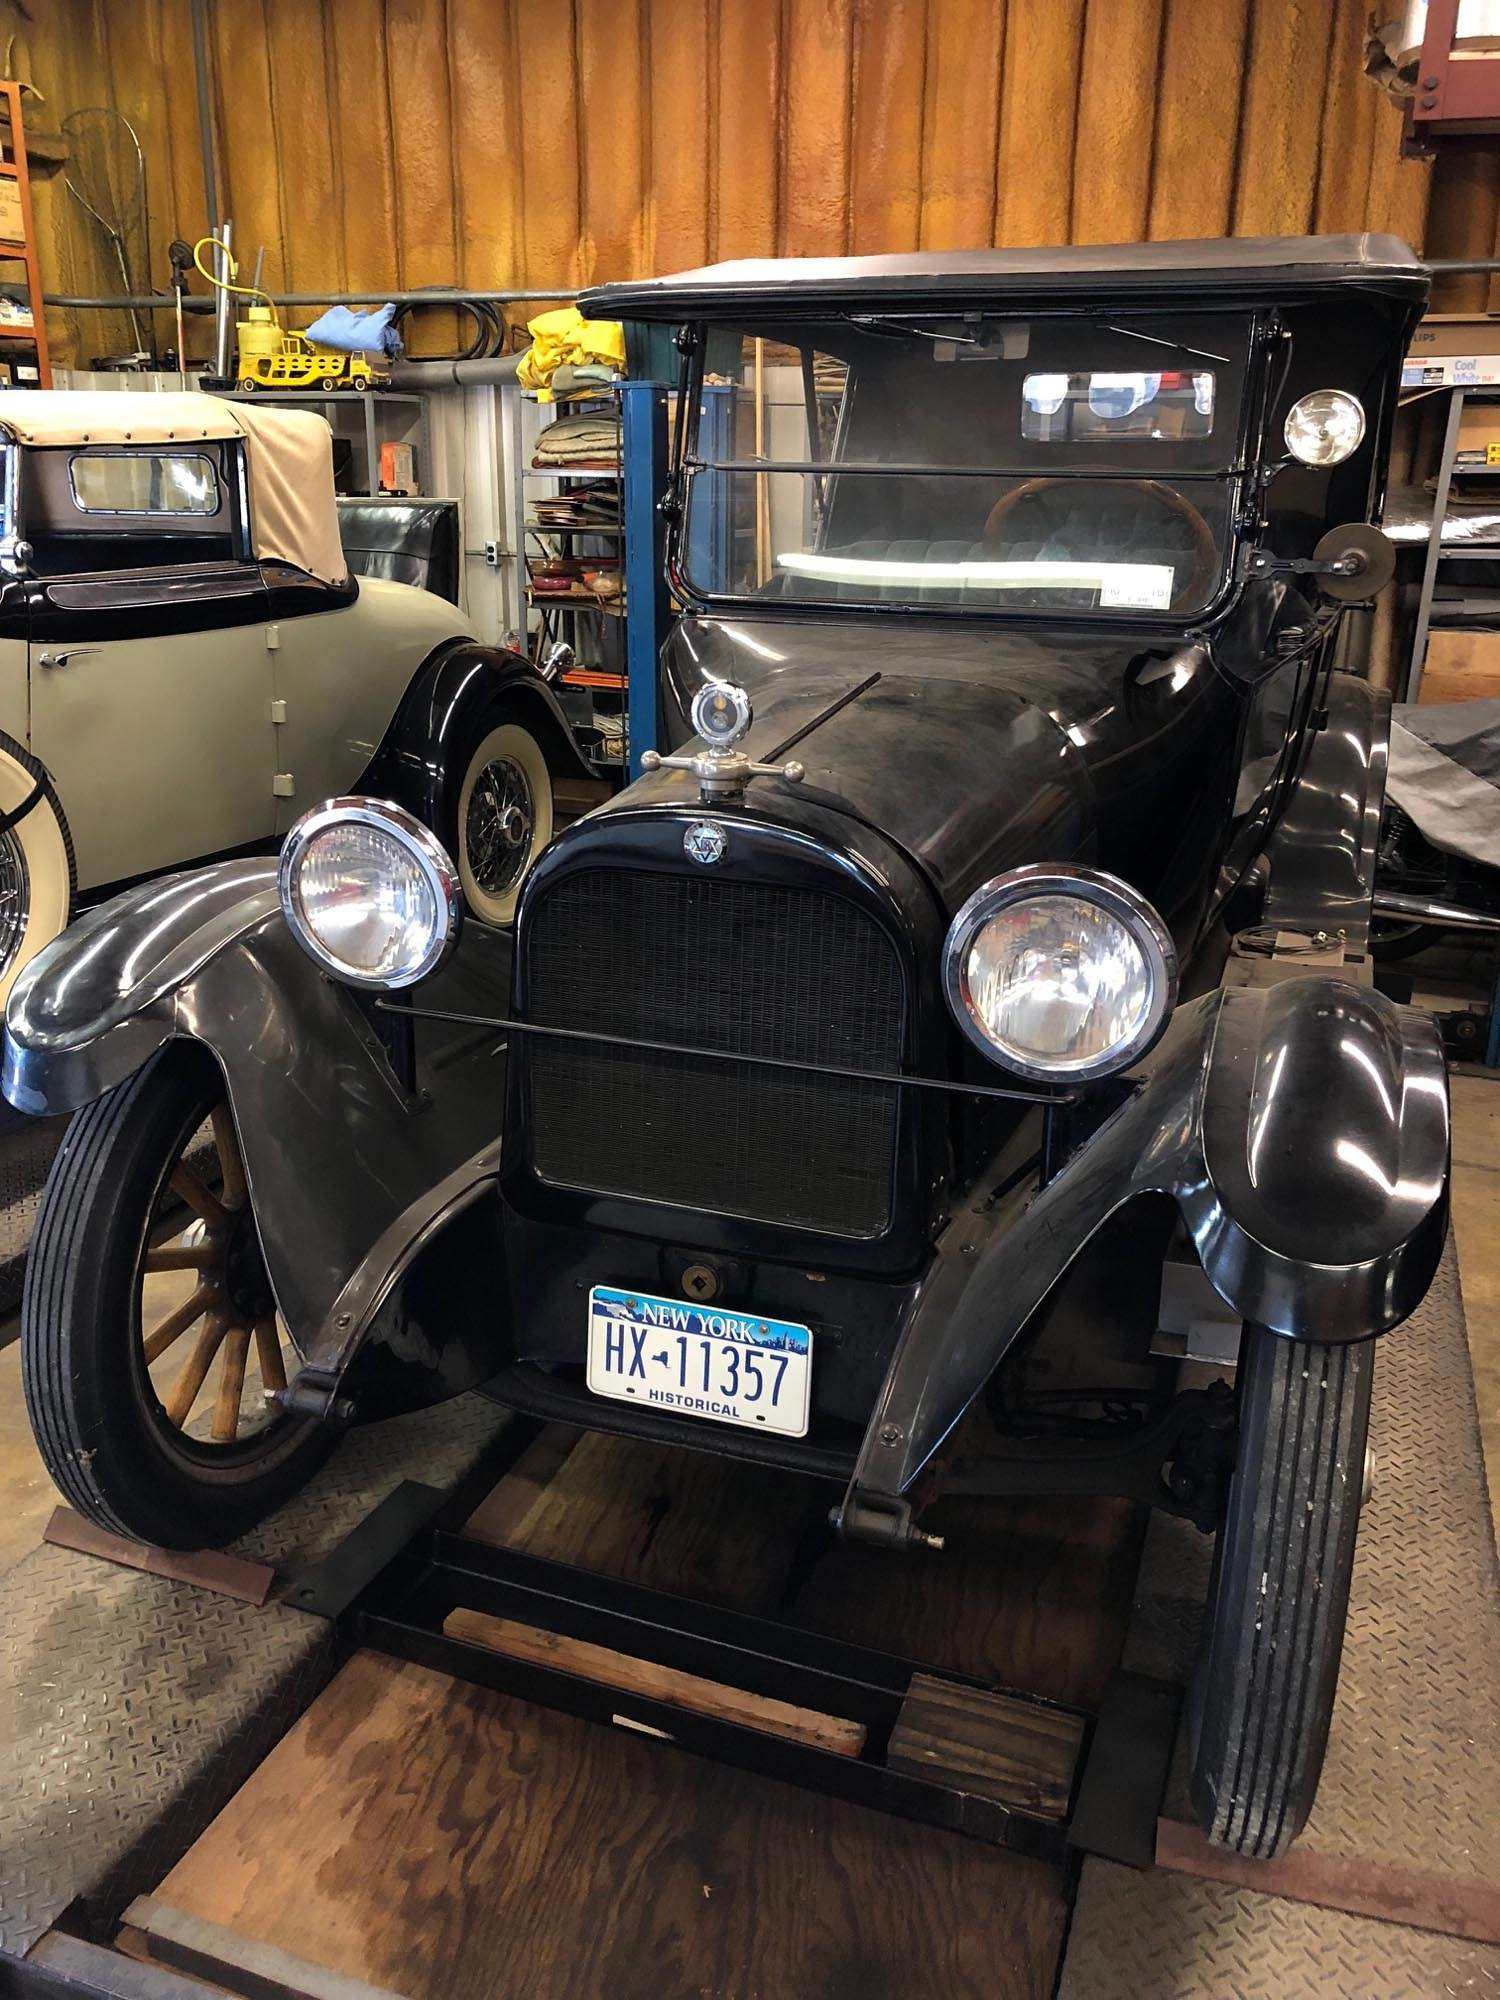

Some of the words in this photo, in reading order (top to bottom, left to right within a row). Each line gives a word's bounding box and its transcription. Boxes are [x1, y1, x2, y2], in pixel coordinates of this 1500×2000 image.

[1413, 333, 1436, 342] LIPS
[1455, 359, 1477, 370] Cool
[642, 1302, 691, 1331] NEW
[696, 1312, 760, 1344] YORK
[649, 1388, 740, 1418] HISTORICAL
